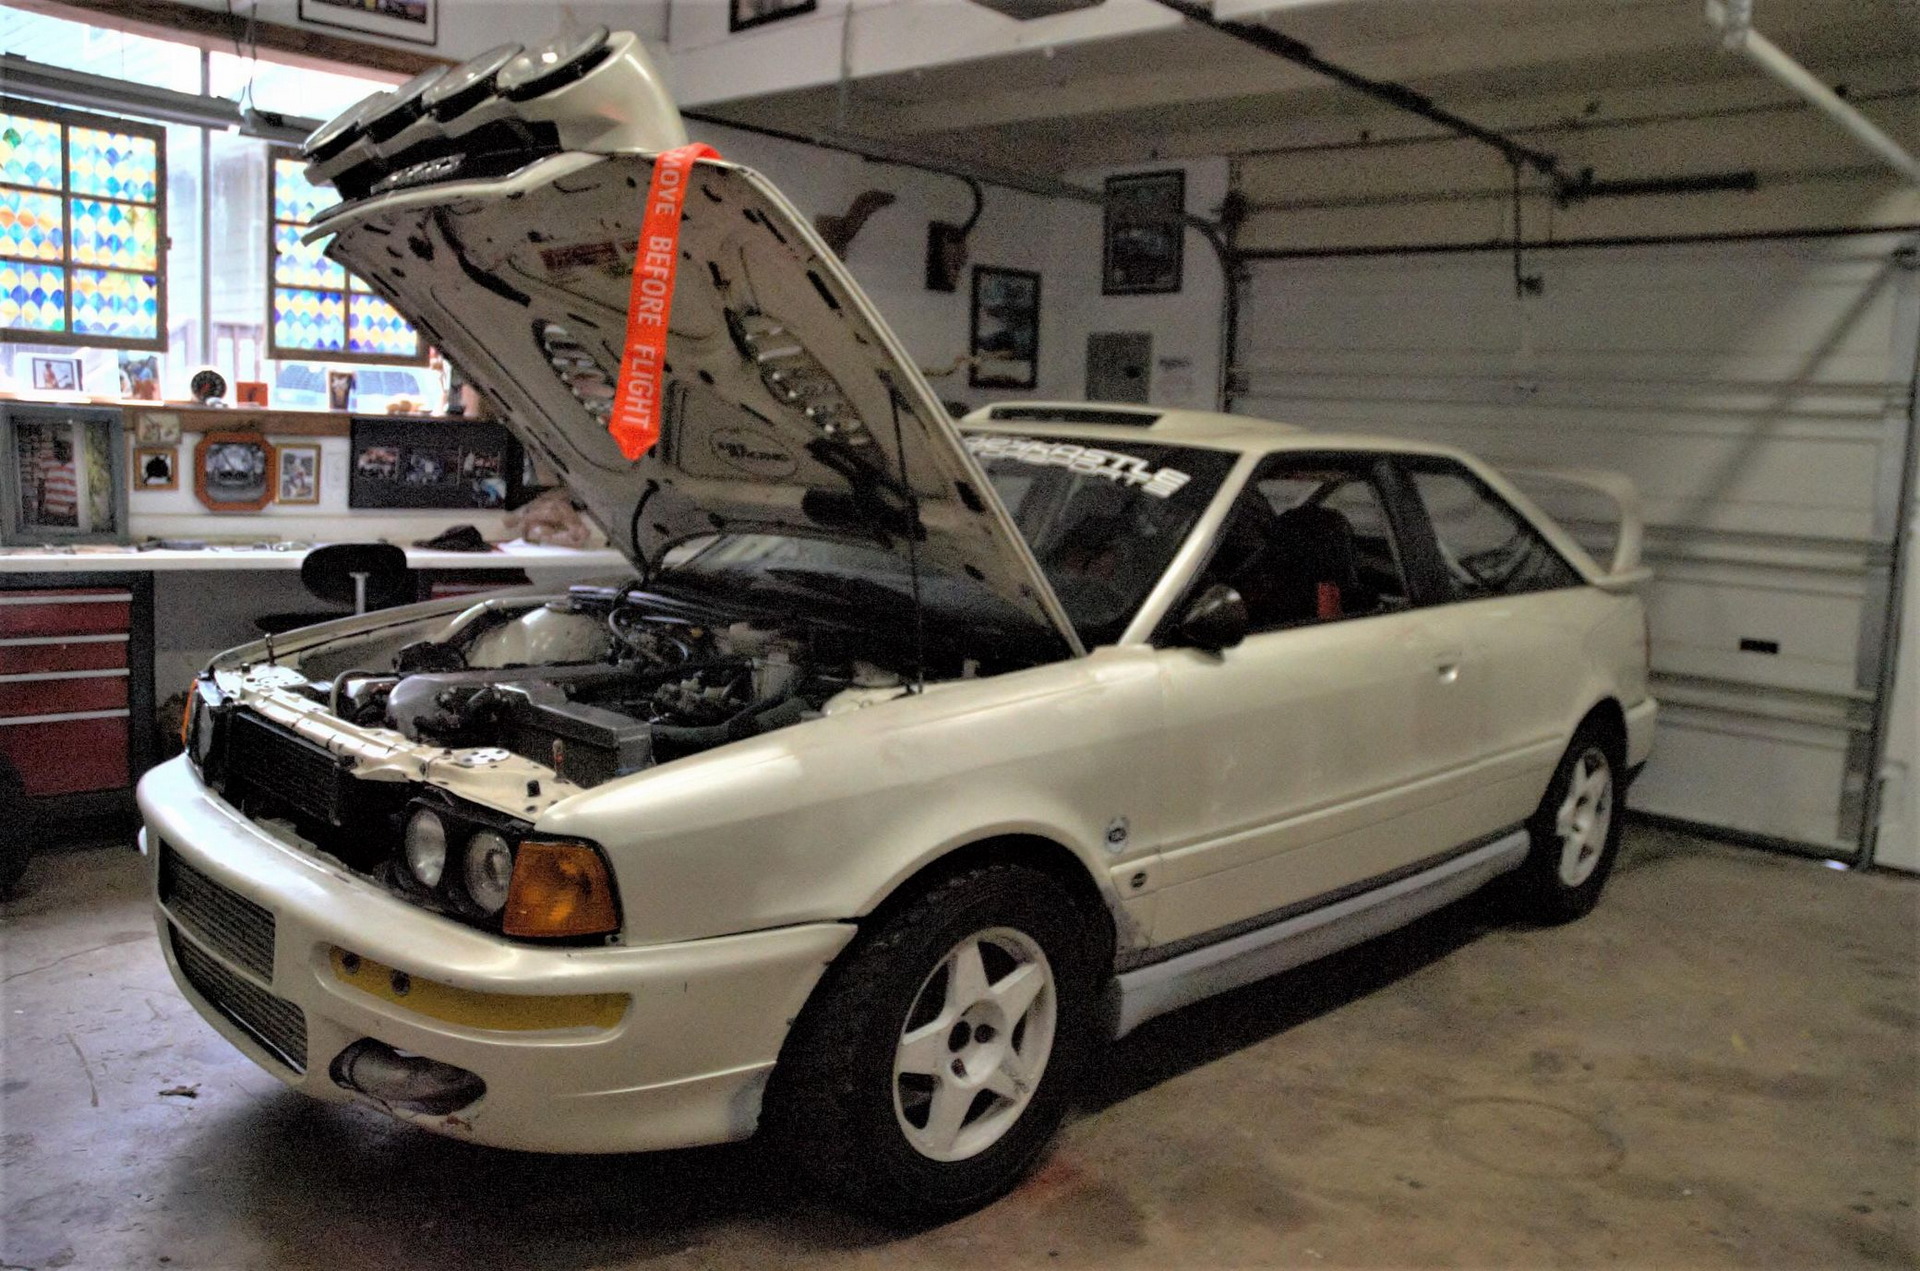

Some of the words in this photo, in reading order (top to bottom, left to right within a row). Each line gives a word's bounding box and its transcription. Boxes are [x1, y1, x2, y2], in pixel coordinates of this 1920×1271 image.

[655, 152, 685, 216] MOVE
[637, 235, 672, 328] BEFORE
[620, 343, 656, 430] FLIGHT
